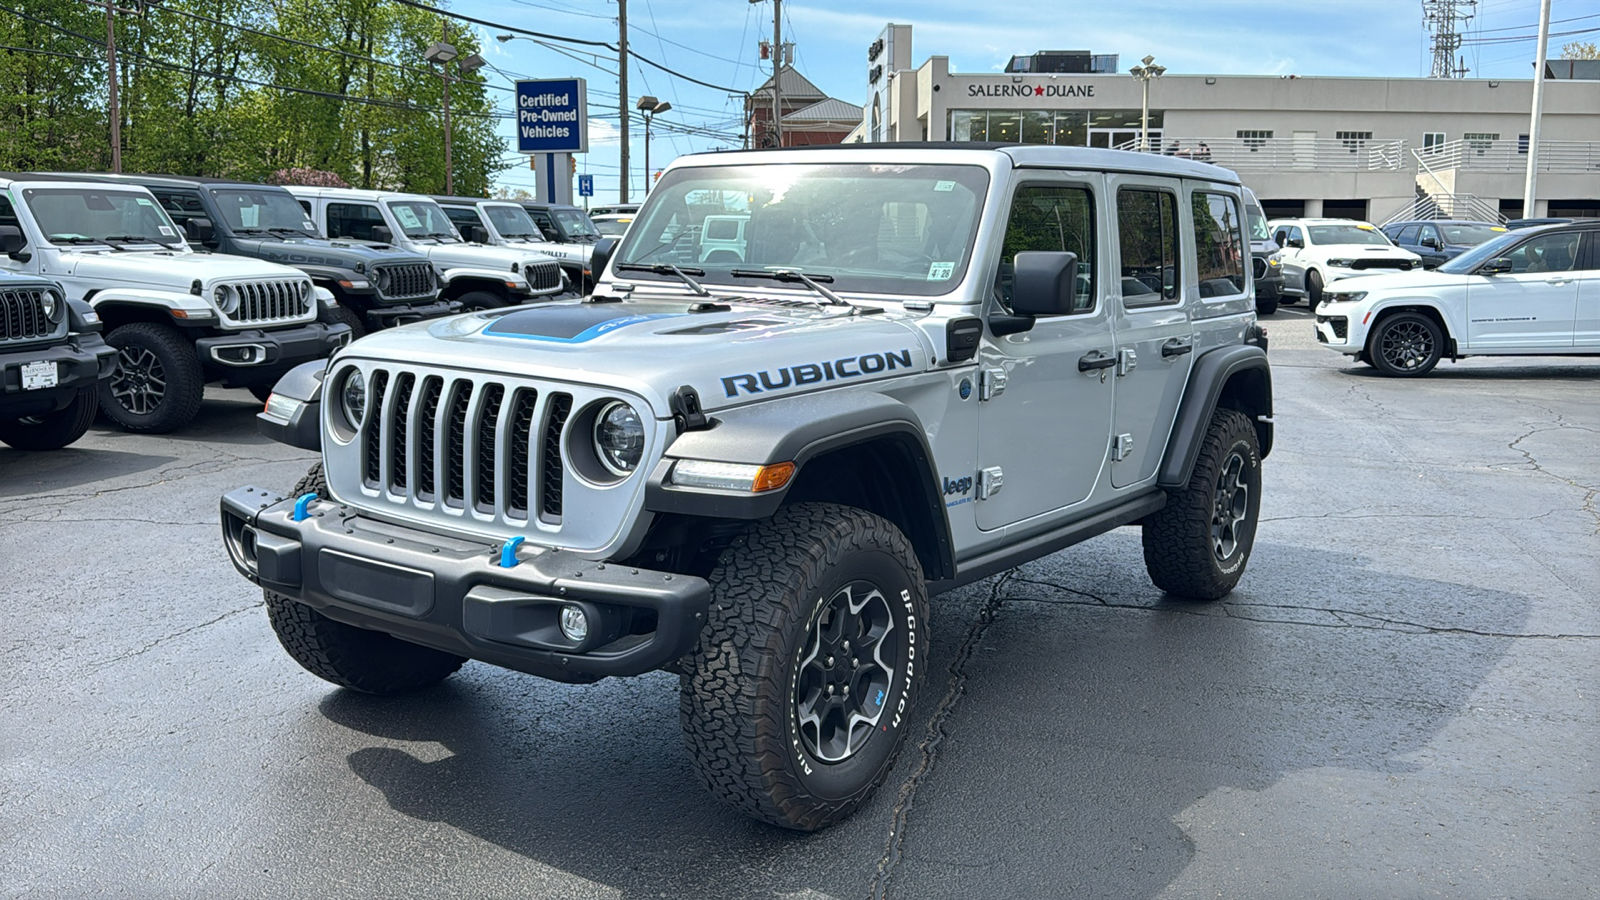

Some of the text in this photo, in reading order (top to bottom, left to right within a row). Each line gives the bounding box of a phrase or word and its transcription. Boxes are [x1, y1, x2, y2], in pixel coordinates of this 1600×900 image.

[967, 84, 1095, 98] SALERNO DUANE
[520, 93, 569, 108] Certified
[520, 108, 577, 123] Pre-Owned
[521, 125, 570, 138] Vehicles
[581, 179, 590, 191] H
[720, 348, 913, 398] RUBICON
[942, 475, 973, 496] Jeep
[891, 588, 917, 729] BFGoodrich
